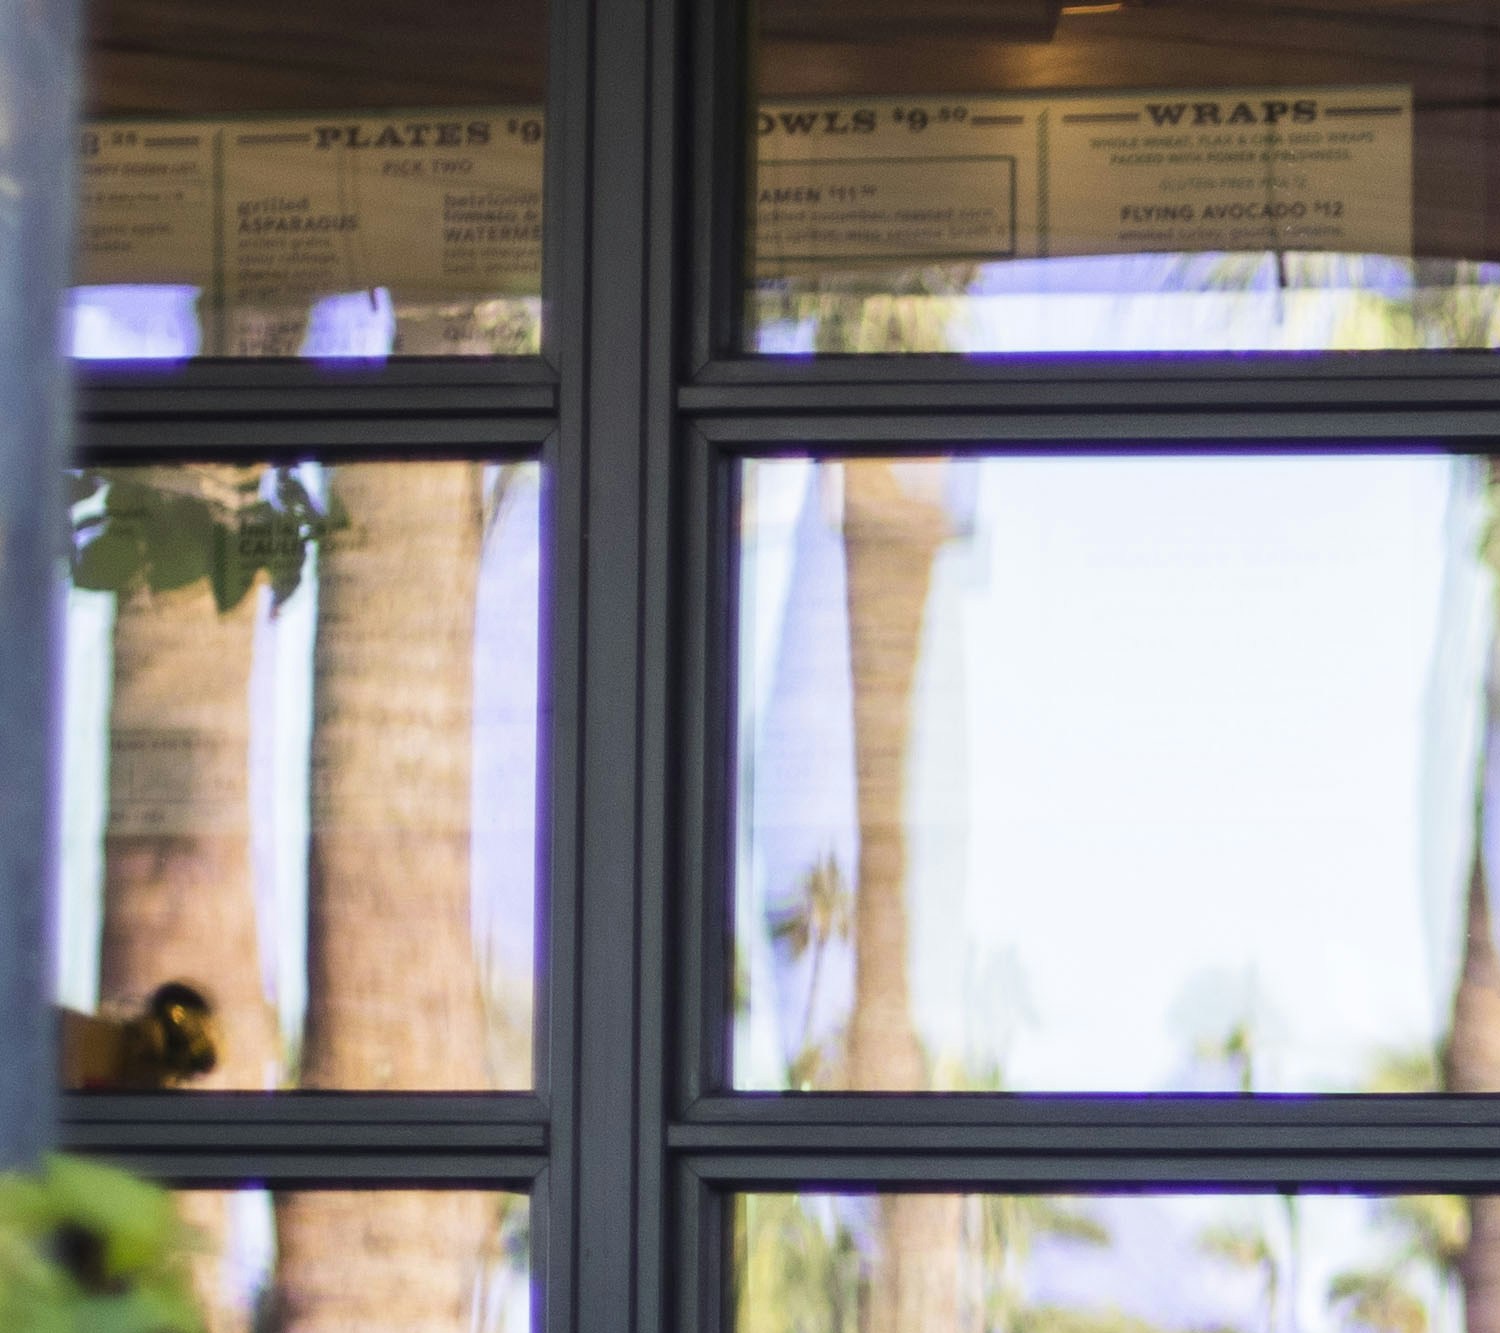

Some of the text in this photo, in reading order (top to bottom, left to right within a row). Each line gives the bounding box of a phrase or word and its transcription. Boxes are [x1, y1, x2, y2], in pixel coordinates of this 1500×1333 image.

[1146, 102, 1317, 127] WRAPS
[314, 119, 491, 151] PLATES
[431, 156, 475, 175] TWO
[1120, 203, 1195, 222] FLYING
[1201, 201, 1307, 221] AVOCADO
[237, 213, 361, 234] ASPARAGUS
